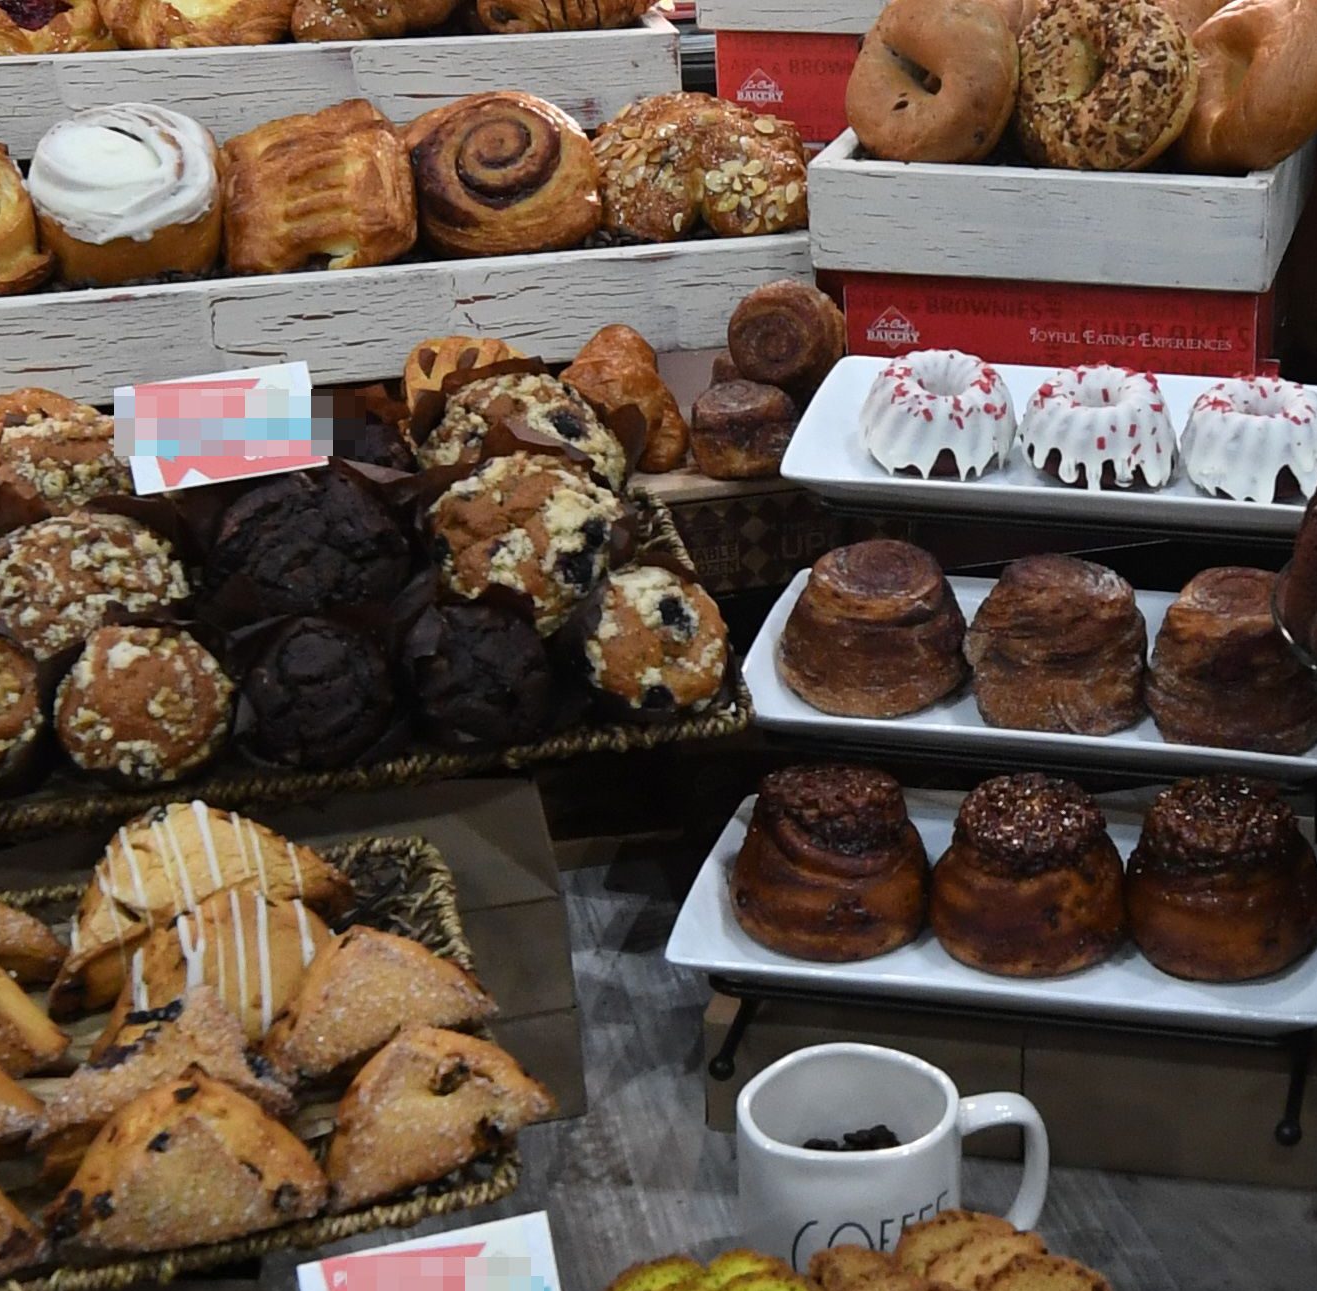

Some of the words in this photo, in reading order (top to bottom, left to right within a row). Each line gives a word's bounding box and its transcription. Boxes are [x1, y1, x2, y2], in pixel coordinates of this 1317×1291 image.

[736, 90, 785, 103] BAKERY
[867, 328, 920, 344] BAKERY
[1138, 332, 1233, 351] EXPERIENCES
